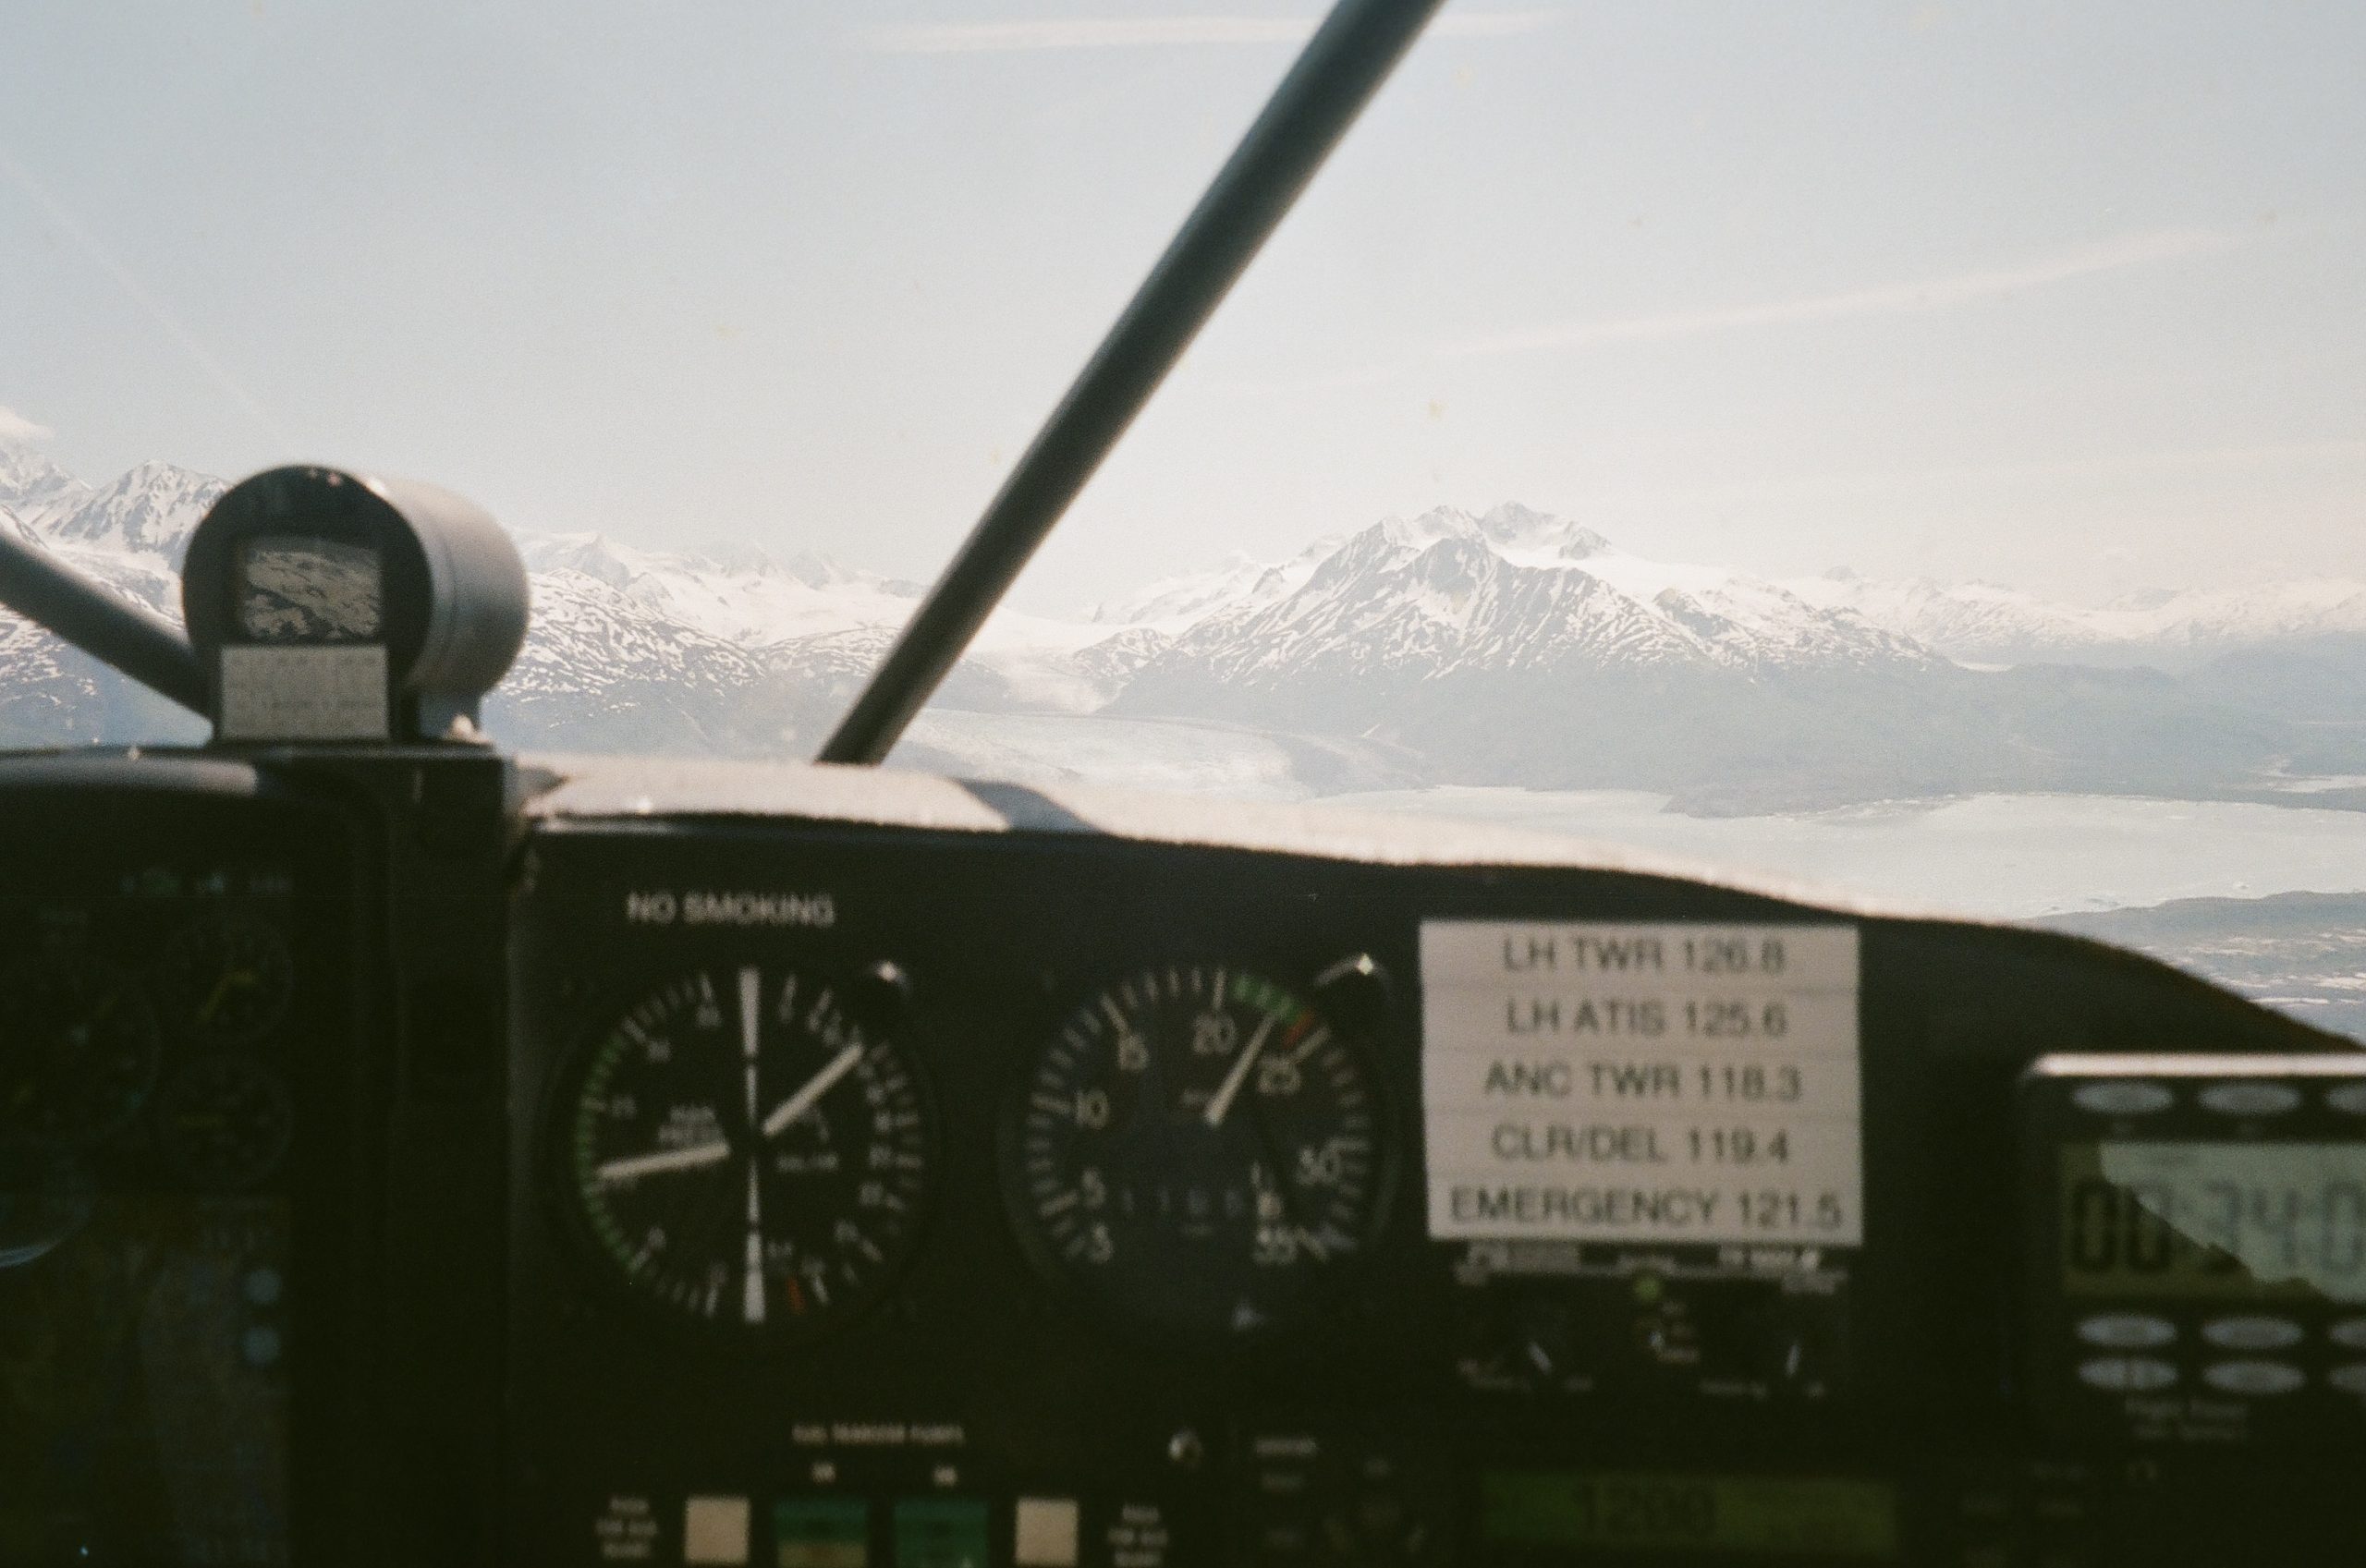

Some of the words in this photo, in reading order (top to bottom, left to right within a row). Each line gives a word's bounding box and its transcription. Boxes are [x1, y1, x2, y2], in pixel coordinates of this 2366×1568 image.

[626, 891, 677, 924] NO
[683, 891, 836, 928] SMOKING
[1504, 937, 1556, 971] LH
[1573, 936, 1664, 970] TWR
[1681, 938, 1786, 975] 126.8
[1506, 1001, 1559, 1035] LH
[1573, 1000, 1666, 1035] ATIS
[1683, 1002, 1788, 1036] 125.6
[1483, 1062, 1571, 1098] ANC
[1589, 1063, 1680, 1098] TWR
[1698, 1064, 1803, 1100] 118.3
[1491, 1124, 1668, 1162] CLR/DEL
[1687, 1128, 1790, 1164] 119.4
[1449, 1186, 1721, 1223] EMERGENCY
[1737, 1191, 1842, 1228] 121.5
